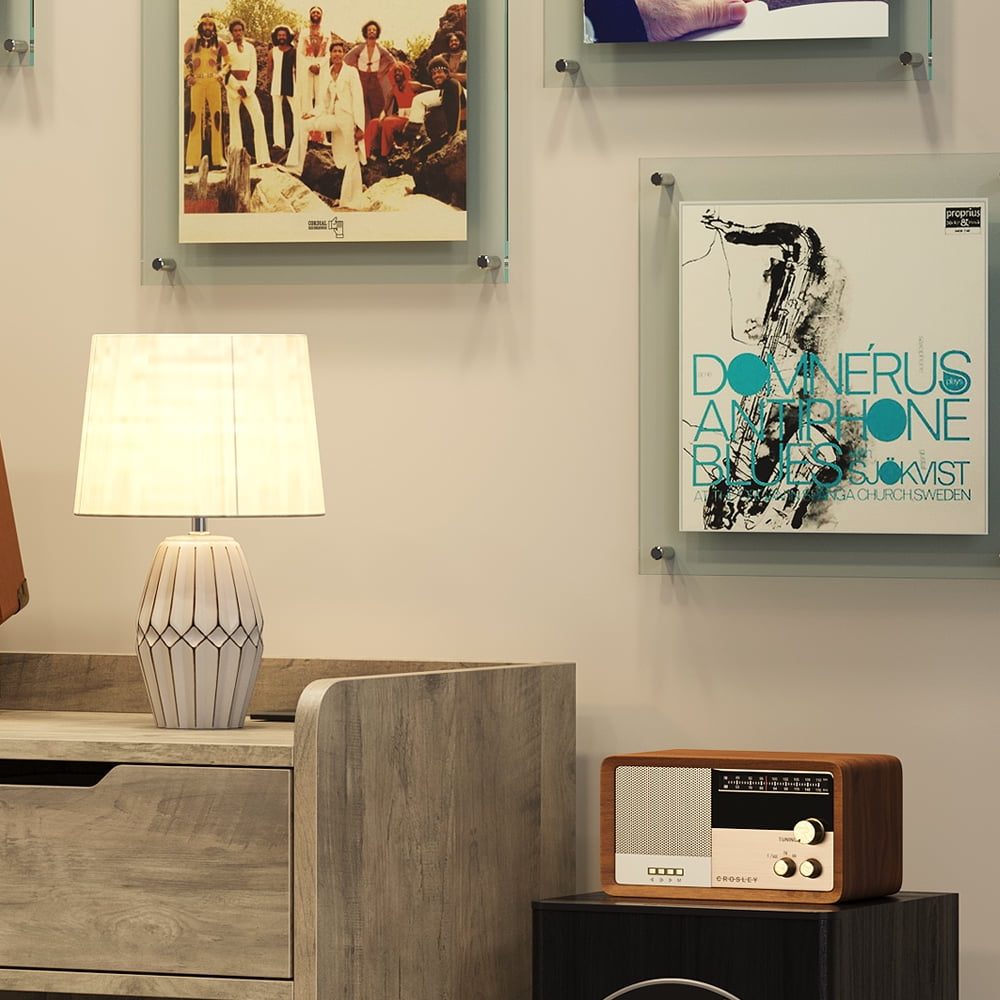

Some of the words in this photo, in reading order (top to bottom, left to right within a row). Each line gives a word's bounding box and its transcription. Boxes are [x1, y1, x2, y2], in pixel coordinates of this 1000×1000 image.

[946, 208, 981, 219] proprius
[692, 343, 972, 396] DOMNÉRUS
[693, 397, 970, 443] ANTIPHONE
[692, 442, 844, 489] BLUES
[848, 456, 971, 487] SJÖKVIST
[716, 875, 759, 884] CROSLEY
